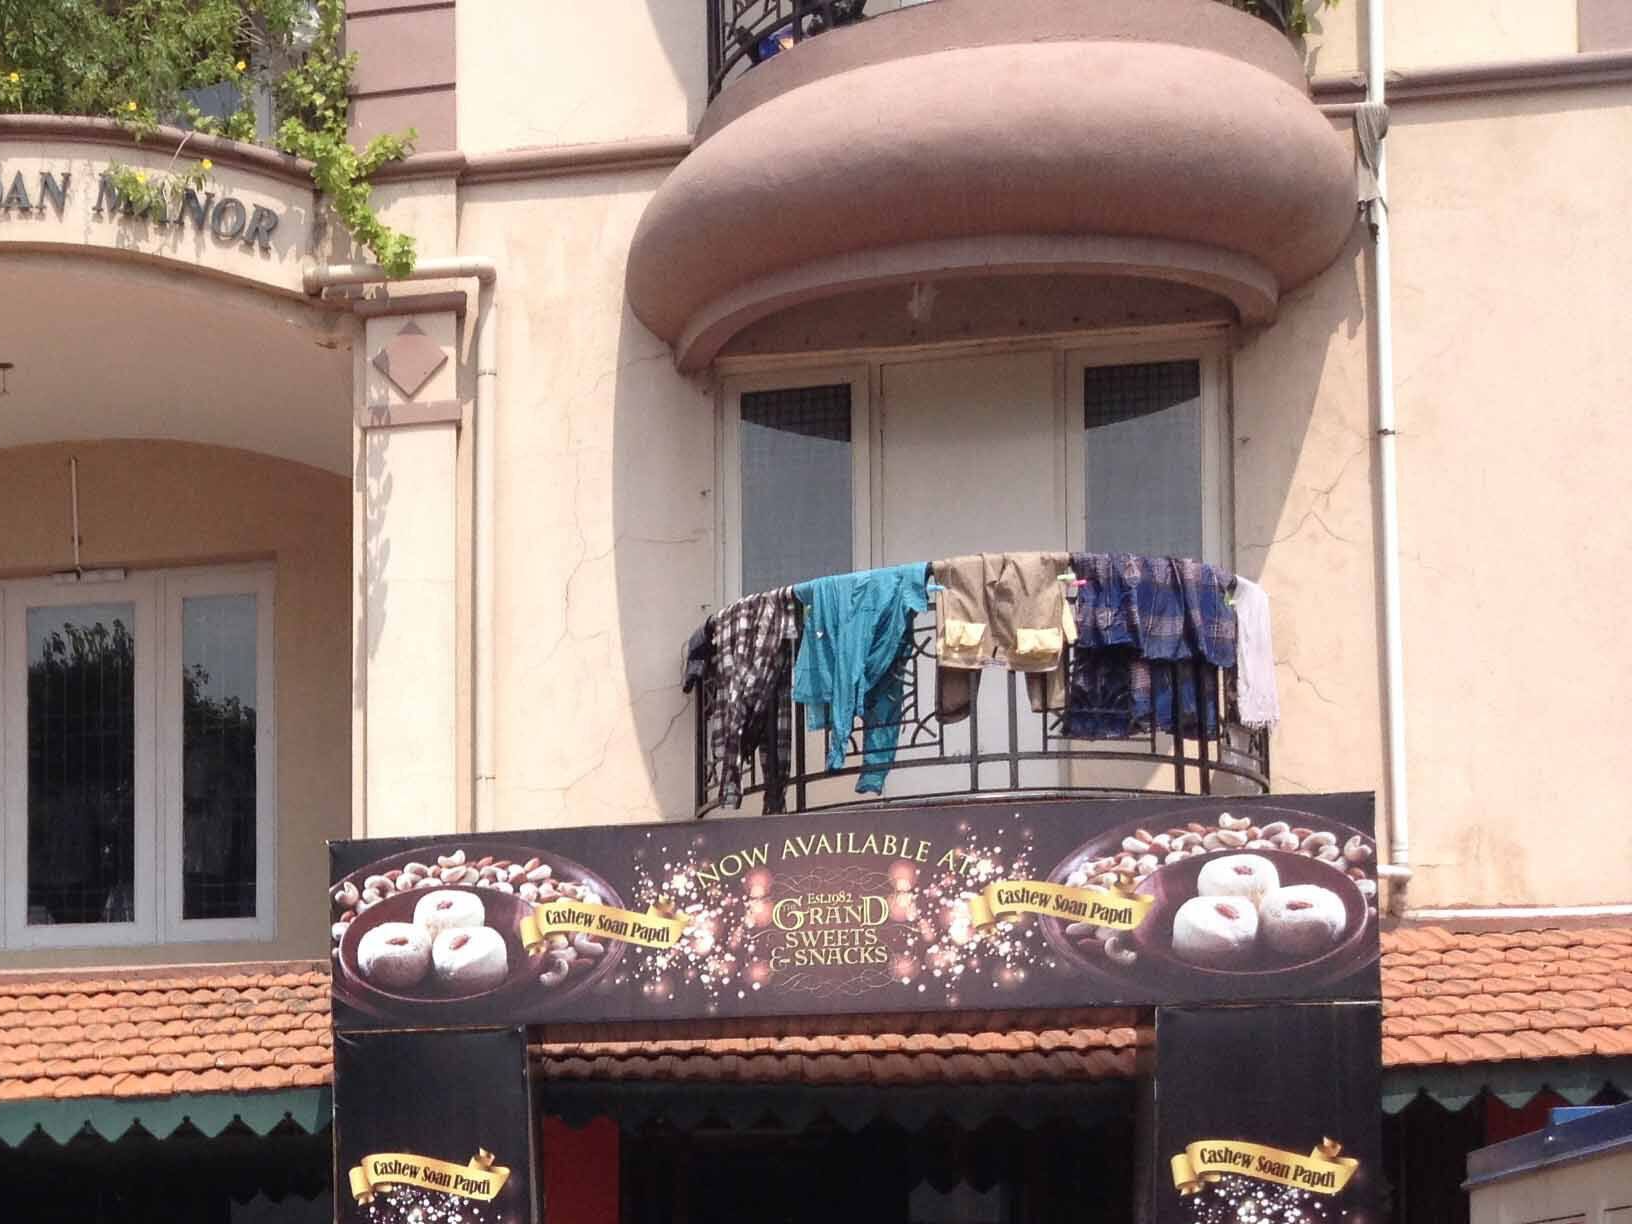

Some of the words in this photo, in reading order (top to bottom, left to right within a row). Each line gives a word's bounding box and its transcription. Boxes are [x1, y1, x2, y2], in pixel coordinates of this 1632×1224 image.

[92, 172, 279, 254] MNOR
[695, 843, 769, 889] NOW
[781, 832, 932, 863] AVAILABLE
[936, 847, 974, 876] AT
[772, 895, 889, 931] GRAND
[997, 887, 1052, 909] Cashew
[1053, 894, 1088, 917] Soan
[1089, 901, 1133, 925] Papdi
[545, 908, 596, 928] Cashew
[597, 914, 628, 937] Soan
[630, 922, 670, 943] Papdi
[785, 928, 878, 949] SWEETS
[794, 945, 889, 967] SNACKS
[373, 1159, 421, 1179] Cashew
[421, 1166, 451, 1187] Soan
[453, 1173, 491, 1195] Papdi
[1200, 1147, 1255, 1168] Cashew
[1256, 1155, 1290, 1179] Soan
[1292, 1165, 1335, 1188] Papdi
